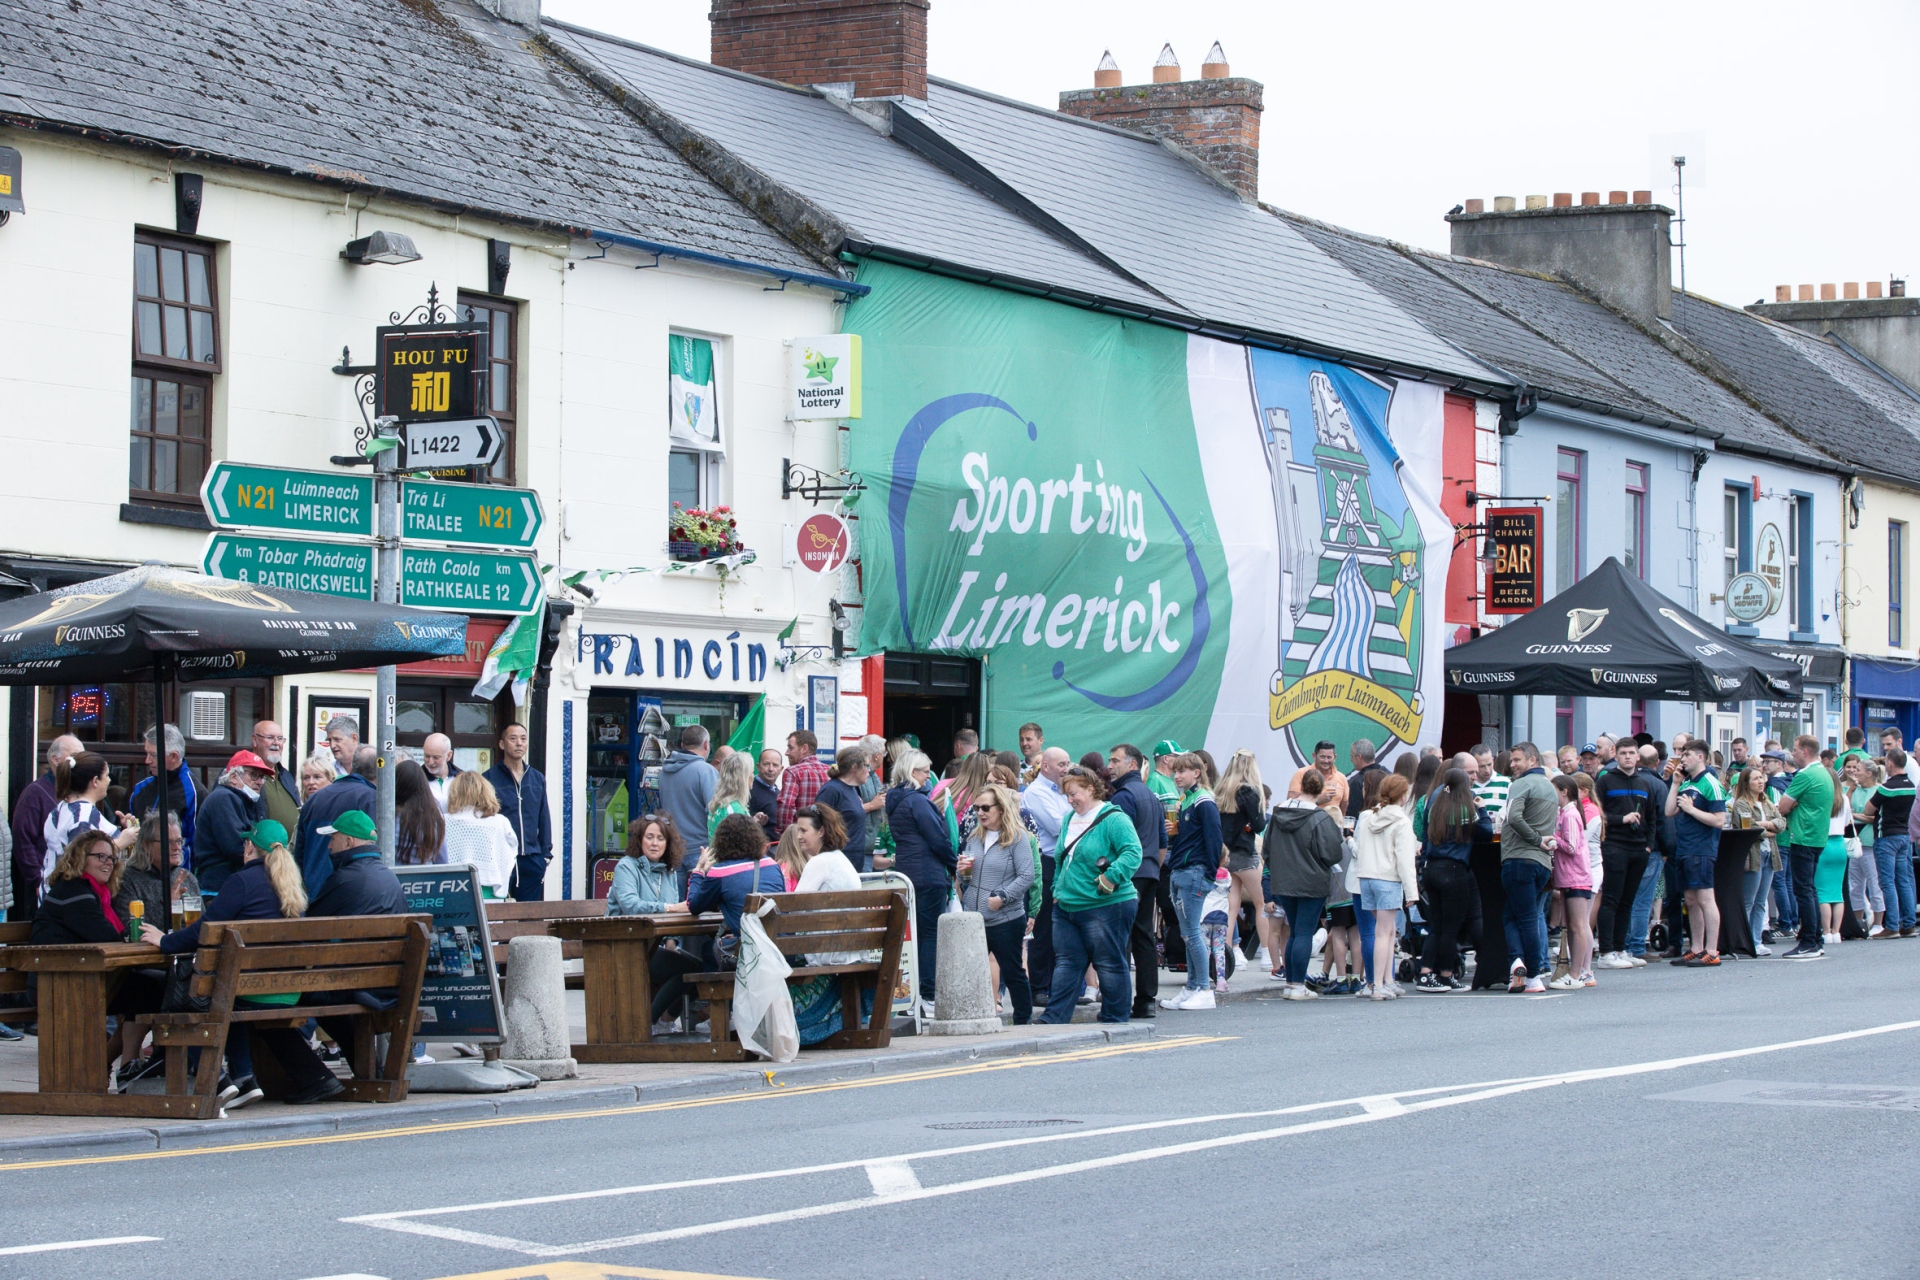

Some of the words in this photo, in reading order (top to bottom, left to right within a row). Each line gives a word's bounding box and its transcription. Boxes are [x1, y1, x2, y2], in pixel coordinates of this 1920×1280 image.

[393, 350, 435, 366] HOU
[442, 348, 469, 365] FU
[798, 386, 844, 399] National
[801, 397, 841, 409] Lottery
[411, 436, 460, 455] L1422
[237, 485, 275, 510] N21
[283, 478, 360, 501] Luimneach
[284, 502, 360, 525] LIMERICK
[407, 489, 429, 508] Trá
[432, 490, 445, 508] Lí
[479, 505, 512, 529] N21
[949, 451, 1148, 562] Sporting
[407, 512, 463, 533] TRALEE
[1503, 519, 1526, 527] BILL
[1494, 529, 1534, 537] CHAWKE
[236, 544, 253, 559] km
[258, 545, 298, 565] Tobar
[304, 548, 367, 573] Phádraig
[404, 556, 437, 575] Ráth
[442, 558, 481, 578] Caola
[495, 561, 511, 576] km
[1495, 543, 1533, 574] BAR
[238, 568, 249, 583] 8
[258, 570, 368, 594] PATRICKSWELL
[406, 580, 491, 601] RATHKEALE
[495, 584, 510, 602] 12
[929, 570, 1181, 654] Limerick
[66, 623, 126, 642] GUINNESS
[262, 619, 309, 629] RAISING
[310, 621, 333, 630] THE
[336, 621, 357, 630] BAR
[299, 629, 330, 637] GUINNESS
[411, 624, 463, 641] GUINNESS
[2, 632, 23, 643] BAR
[1525, 644, 1613, 654] GUINNESS
[1695, 643, 1725, 657] GUIN
[1463, 671, 1516, 684] GUINNESS
[1603, 670, 1658, 684] GUINNESS
[1330, 682, 1345, 699] ar
[1345, 677, 1411, 734] Luimneach
[1868, 707, 1877, 717] THIS
[1881, 708, 1896, 718] BETTING
[386, 741, 393, 751] 2
[401, 880, 436, 895] GET
[438, 879, 470, 893] FIX
[407, 897, 445, 908] DARE
